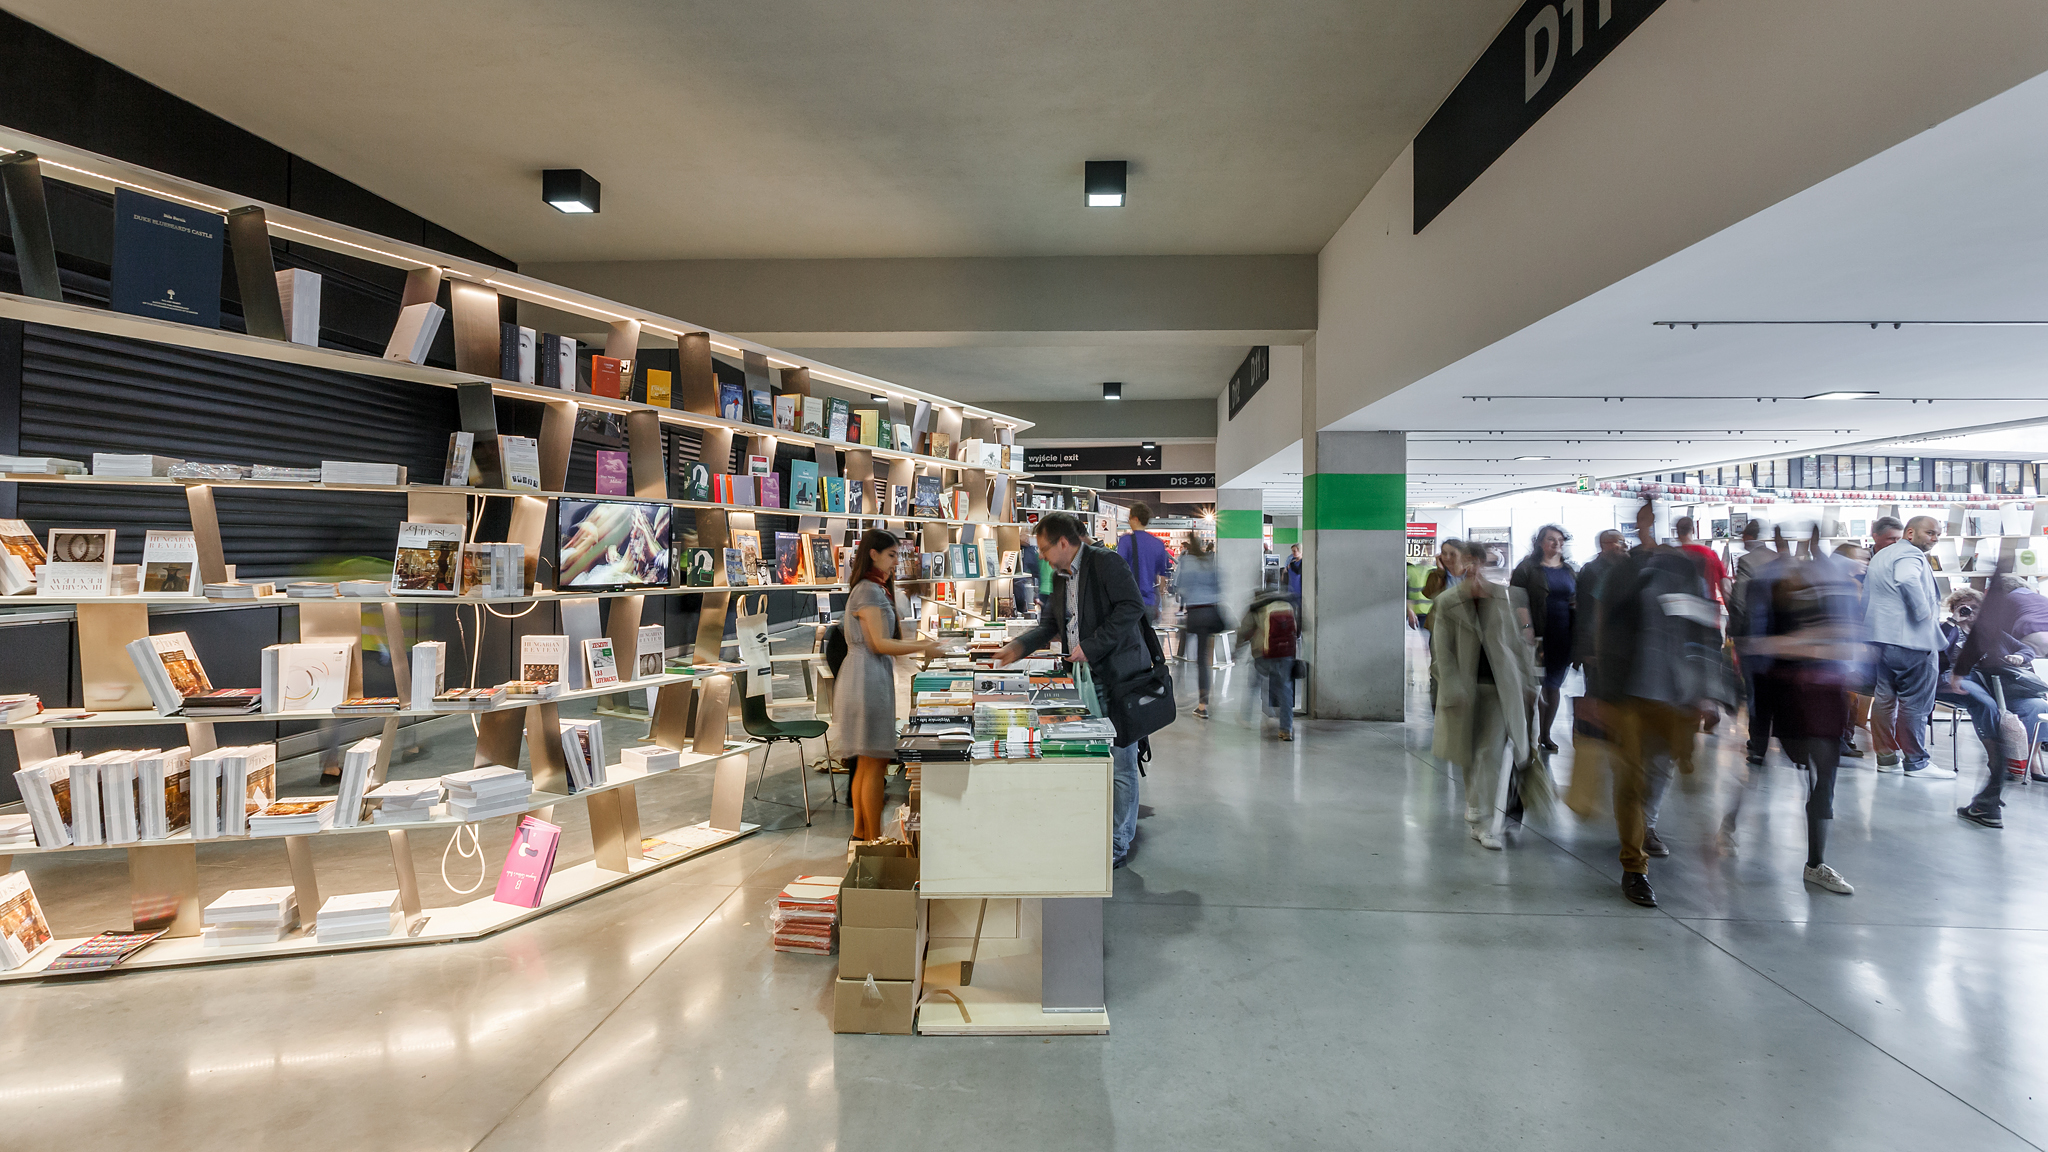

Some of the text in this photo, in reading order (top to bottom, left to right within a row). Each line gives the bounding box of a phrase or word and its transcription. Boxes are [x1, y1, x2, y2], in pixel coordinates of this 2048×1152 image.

[133, 214, 152, 223] DUKE
[191, 229, 213, 239] CASTLE
[1028, 453, 1079, 463] wyjście exit
